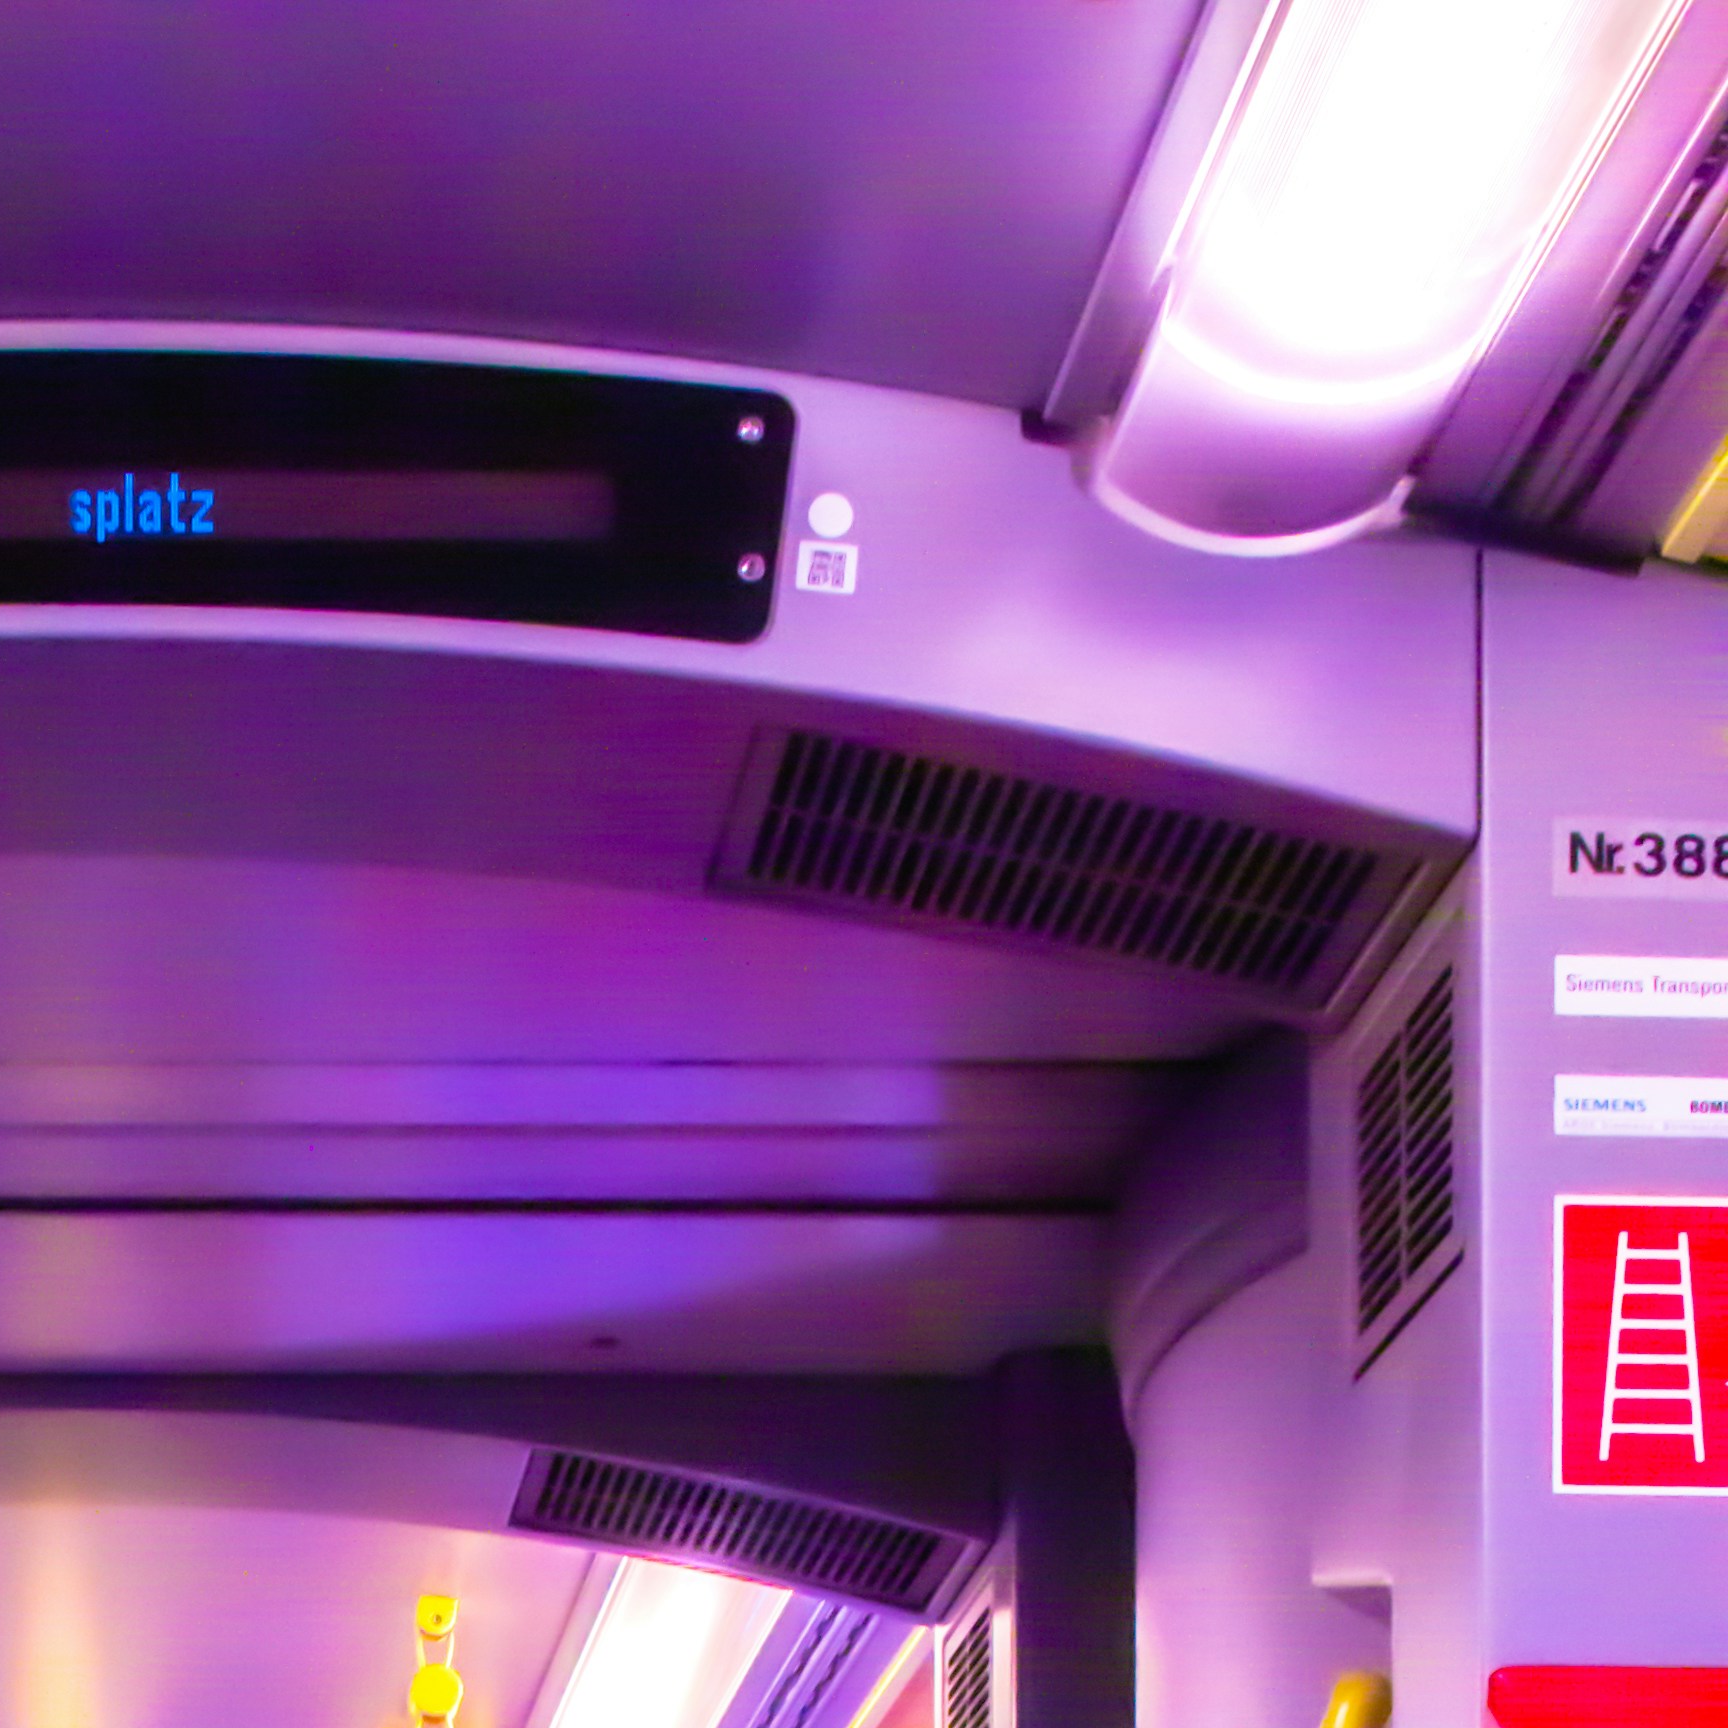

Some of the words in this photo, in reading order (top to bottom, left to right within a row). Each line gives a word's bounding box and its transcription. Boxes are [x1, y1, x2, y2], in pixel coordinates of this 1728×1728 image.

[69, 471, 215, 544] splatz
[1566, 973, 1643, 993] Siemens
[1563, 1098, 1647, 1112] SIEMENS
